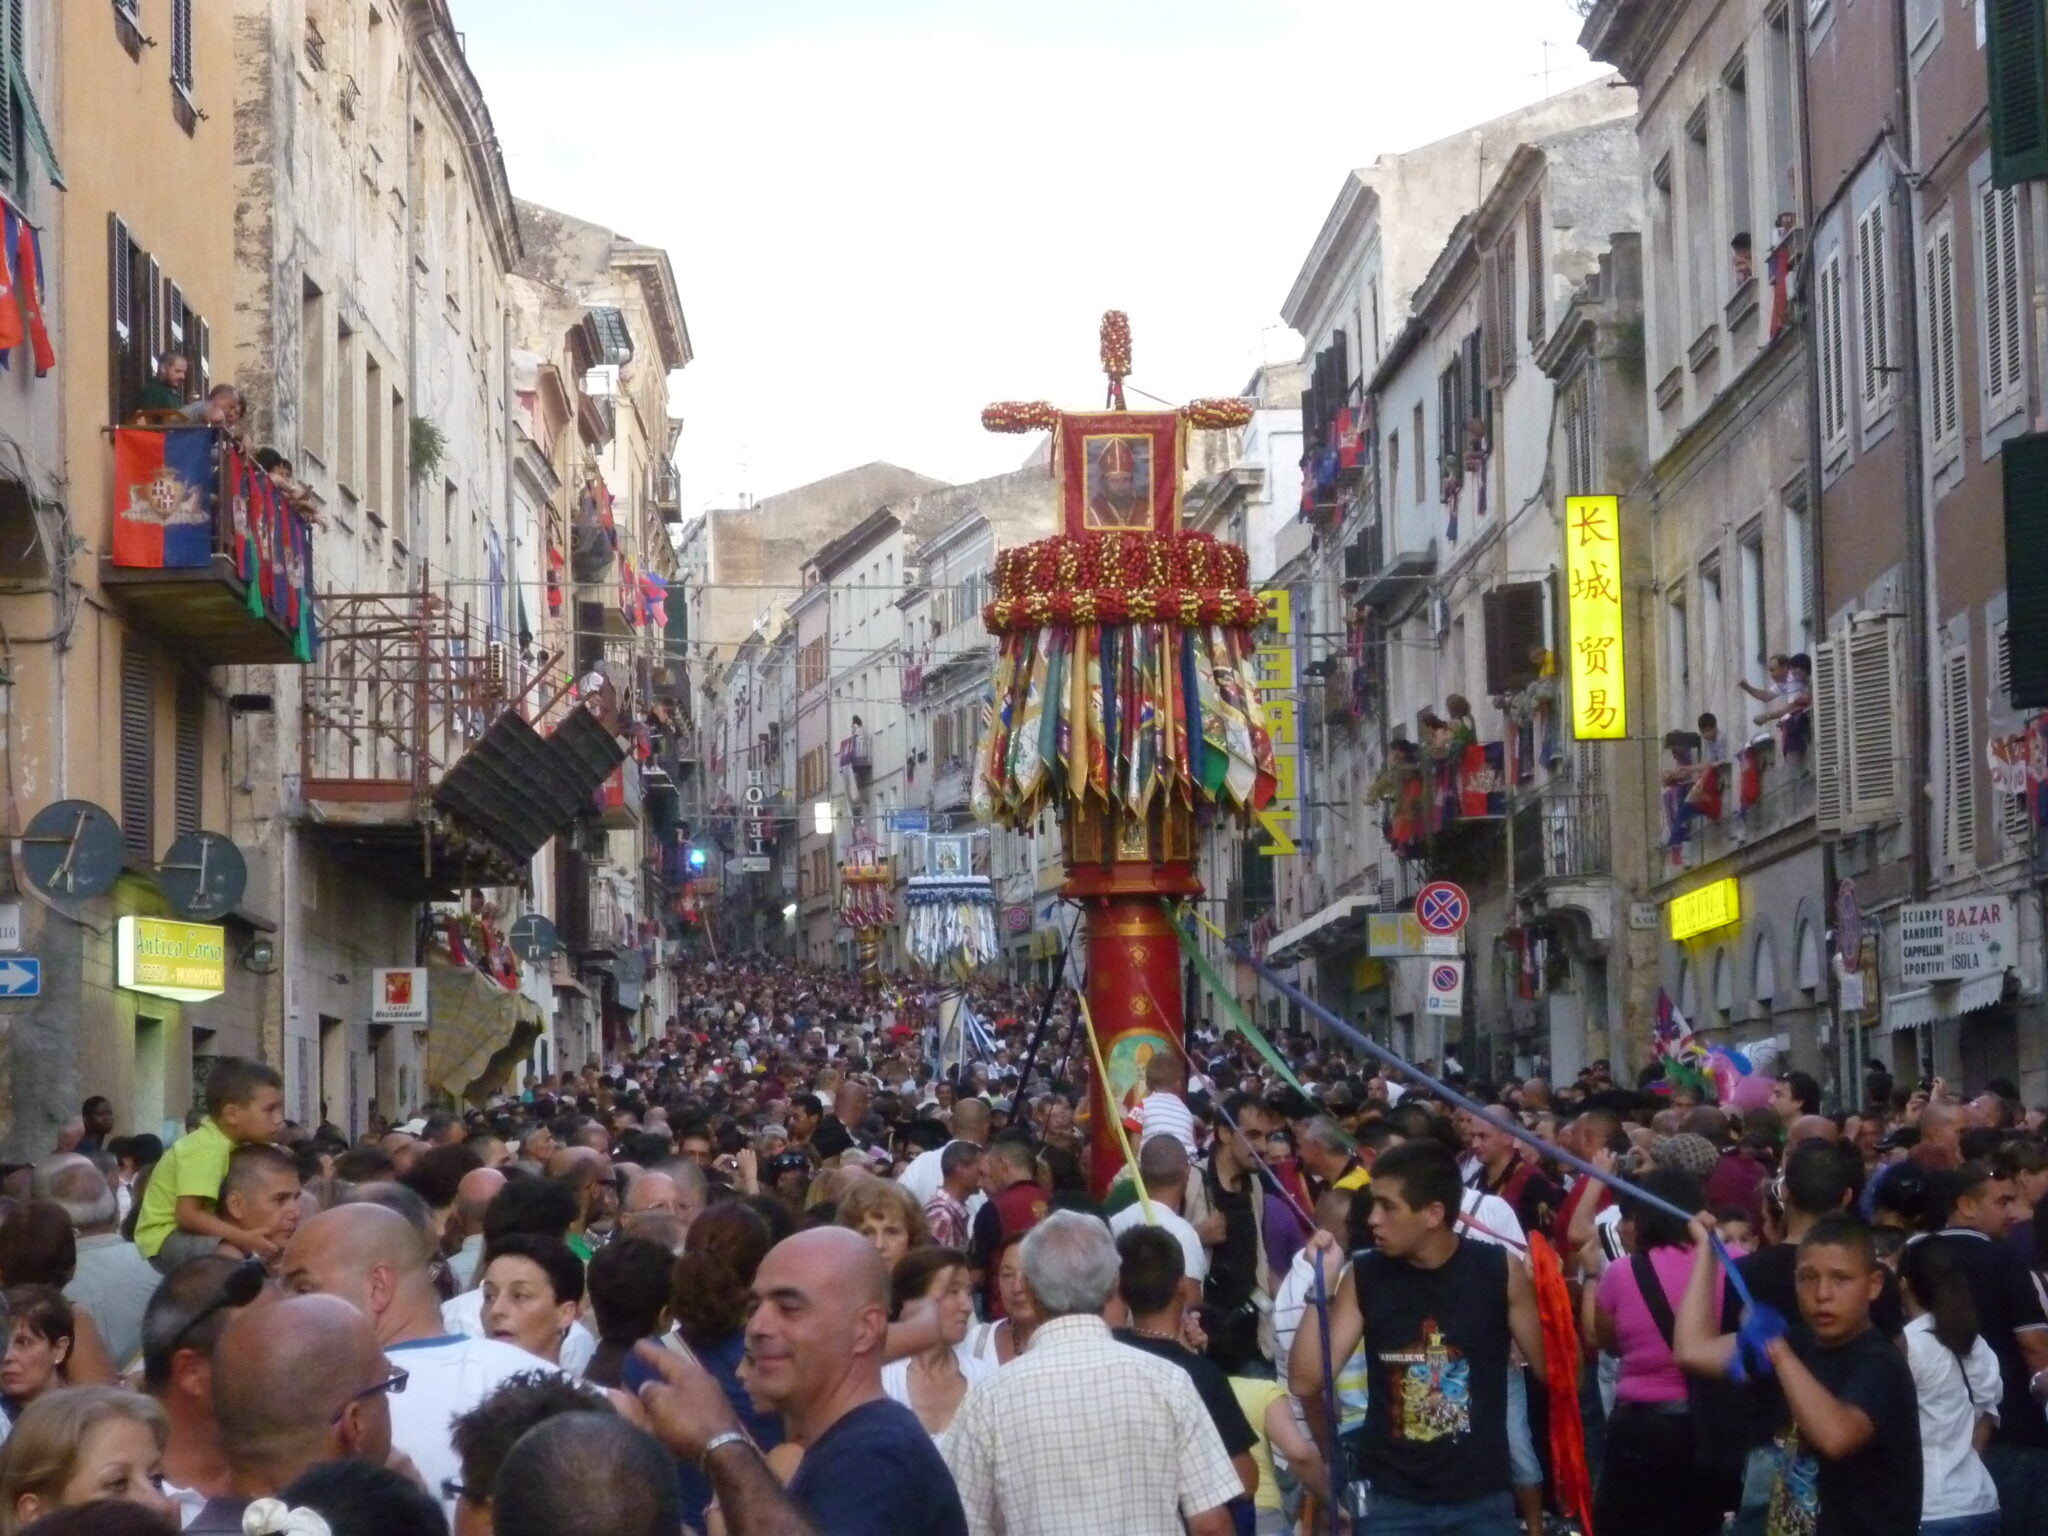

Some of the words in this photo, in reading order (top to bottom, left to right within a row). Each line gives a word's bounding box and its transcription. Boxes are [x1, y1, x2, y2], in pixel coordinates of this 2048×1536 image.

[1570, 506, 1619, 730] 长城贸易
[1903, 909, 1944, 923] SCIARPE
[1946, 904, 2001, 928] BAZAR
[1903, 926, 1944, 940] BANDIERE
[136, 926, 183, 957] Antico
[186, 930, 223, 960] Corso
[1903, 944, 1945, 958] CAPPELLINI
[1904, 961, 1945, 976] SPORTIVI
[1951, 953, 1980, 970] ISOLA
